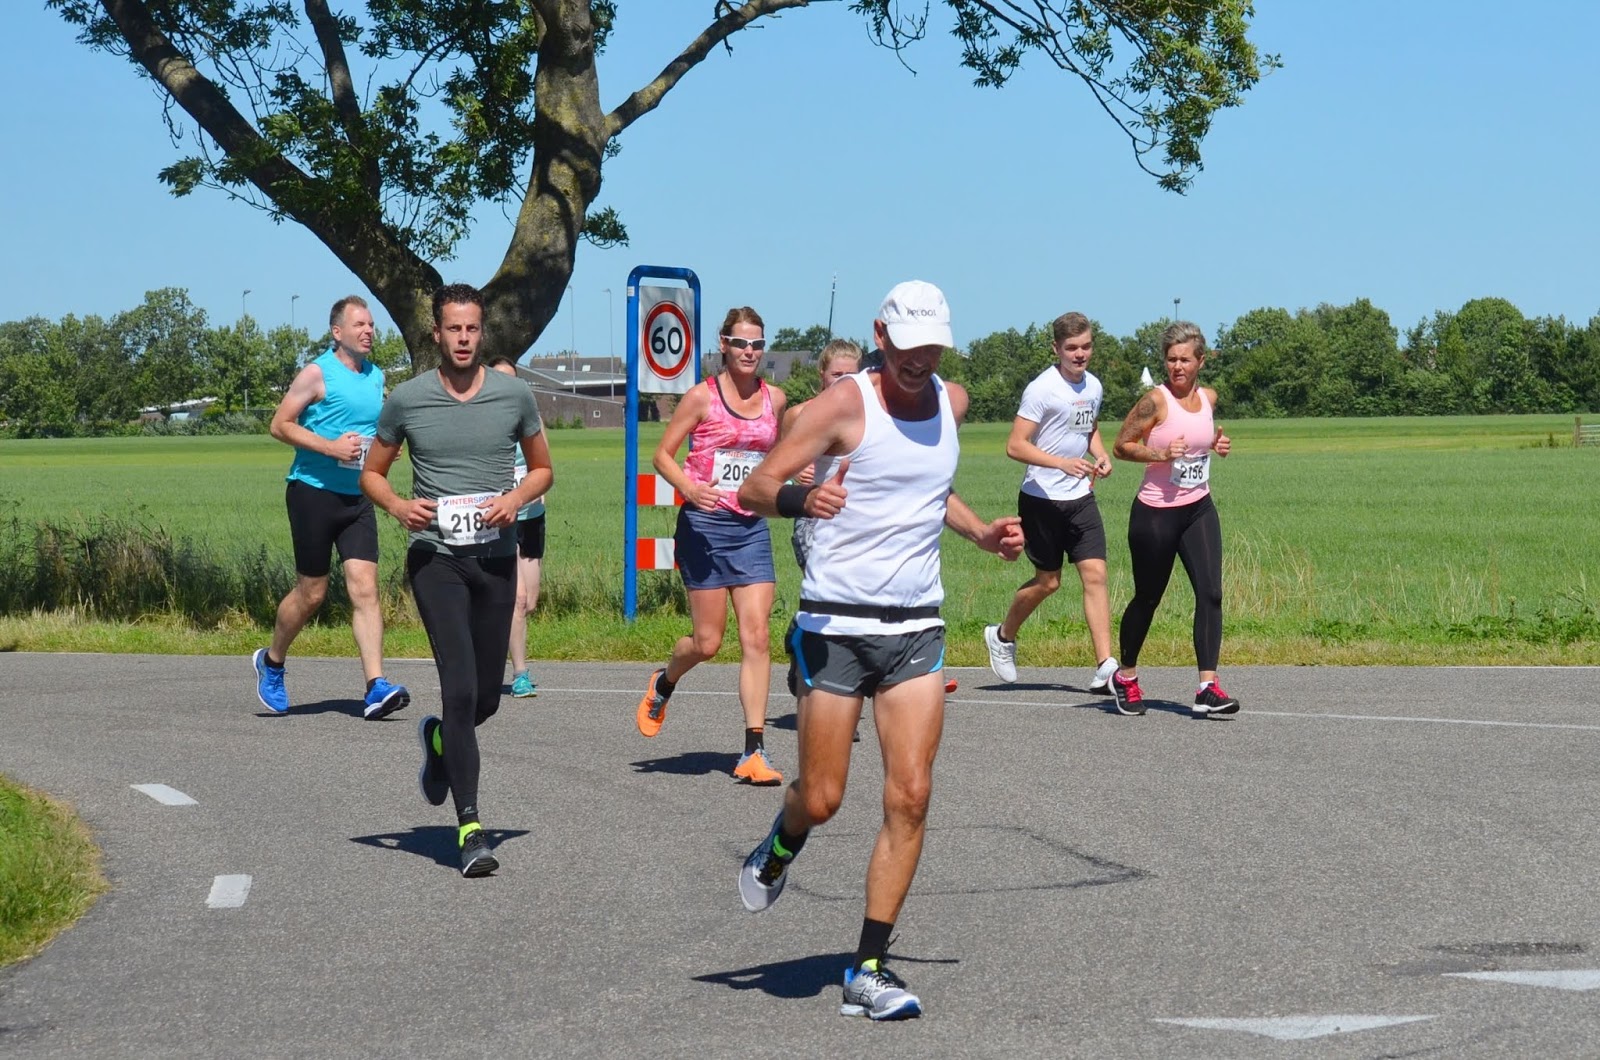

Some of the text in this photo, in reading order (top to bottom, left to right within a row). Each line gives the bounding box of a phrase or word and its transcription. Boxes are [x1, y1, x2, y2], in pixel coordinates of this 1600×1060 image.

[651, 326, 683, 355] 60
[1075, 410, 1094, 426] 2173
[722, 463, 757, 481] 206
[1180, 464, 1204, 480] 2156
